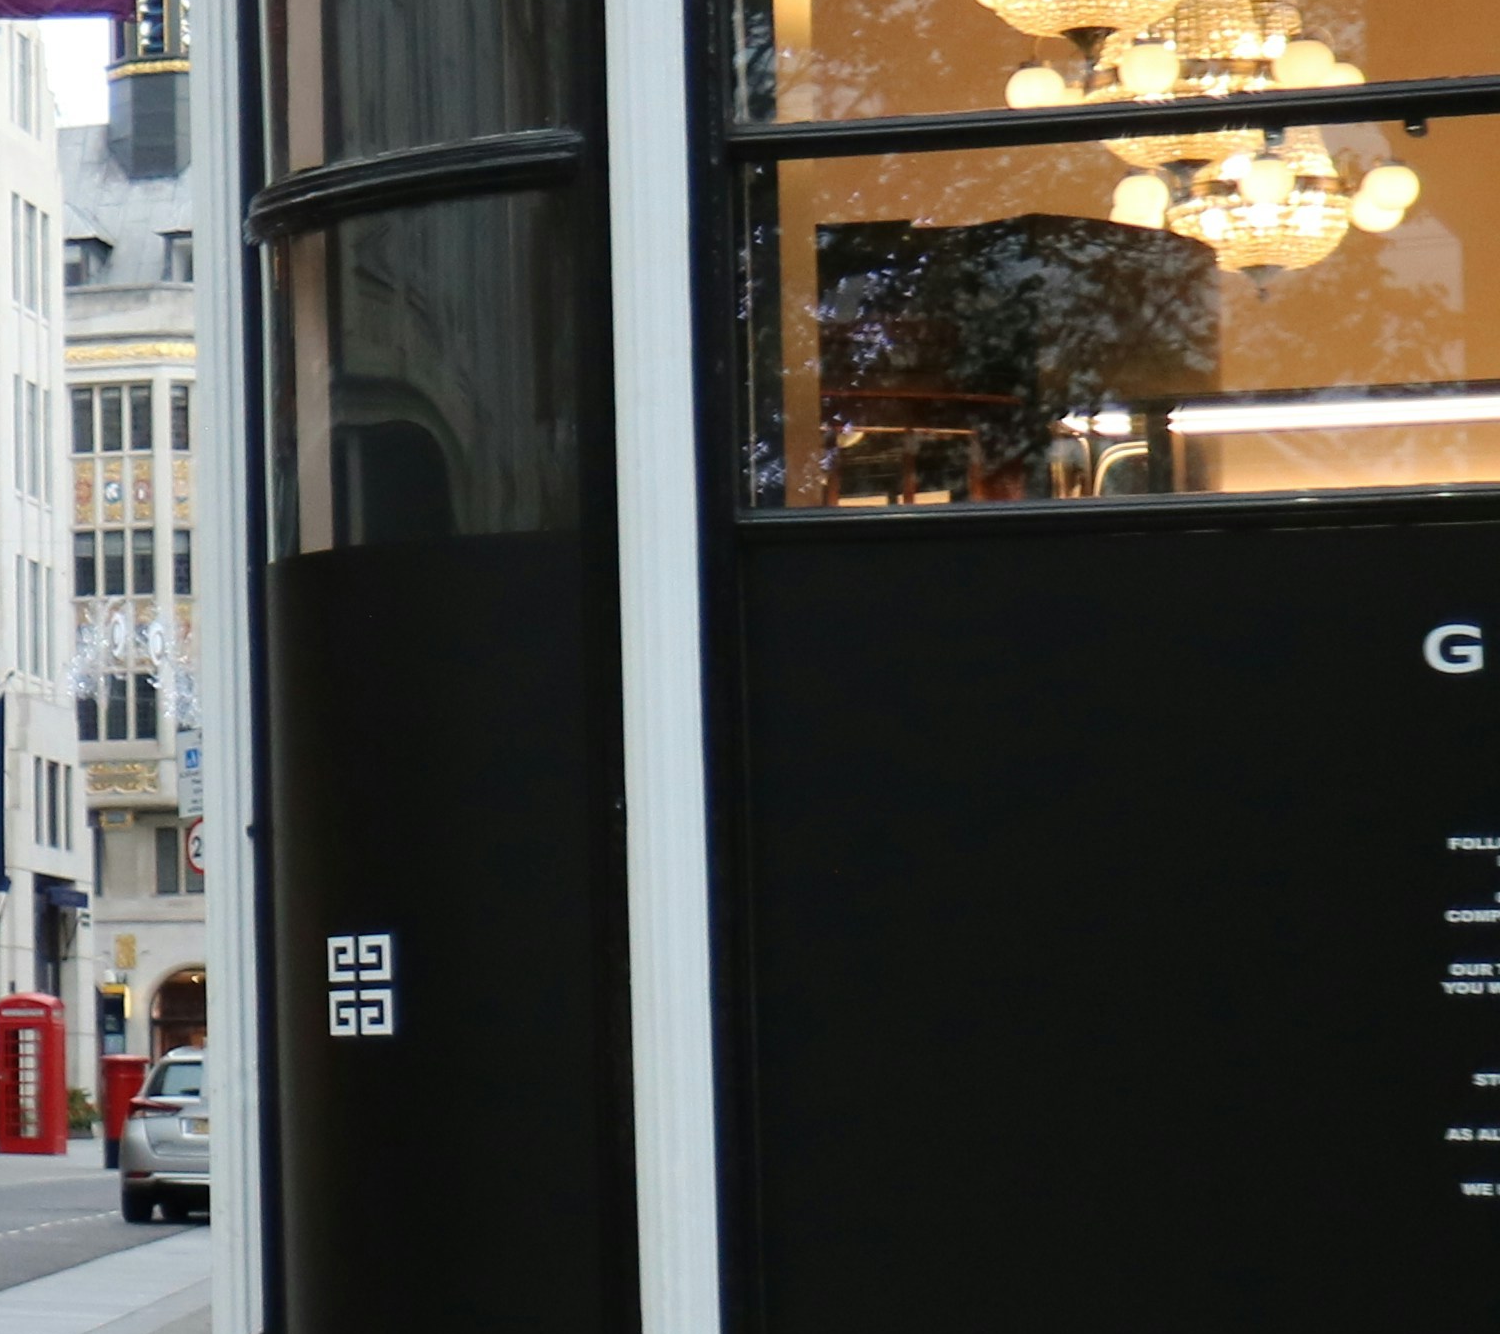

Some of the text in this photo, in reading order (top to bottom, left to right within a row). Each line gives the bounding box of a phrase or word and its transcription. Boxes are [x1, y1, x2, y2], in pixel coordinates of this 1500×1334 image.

[1448, 963, 1494, 976] OUR
[1440, 982, 1484, 995] YOU
[1444, 1128, 1473, 1141] AS
